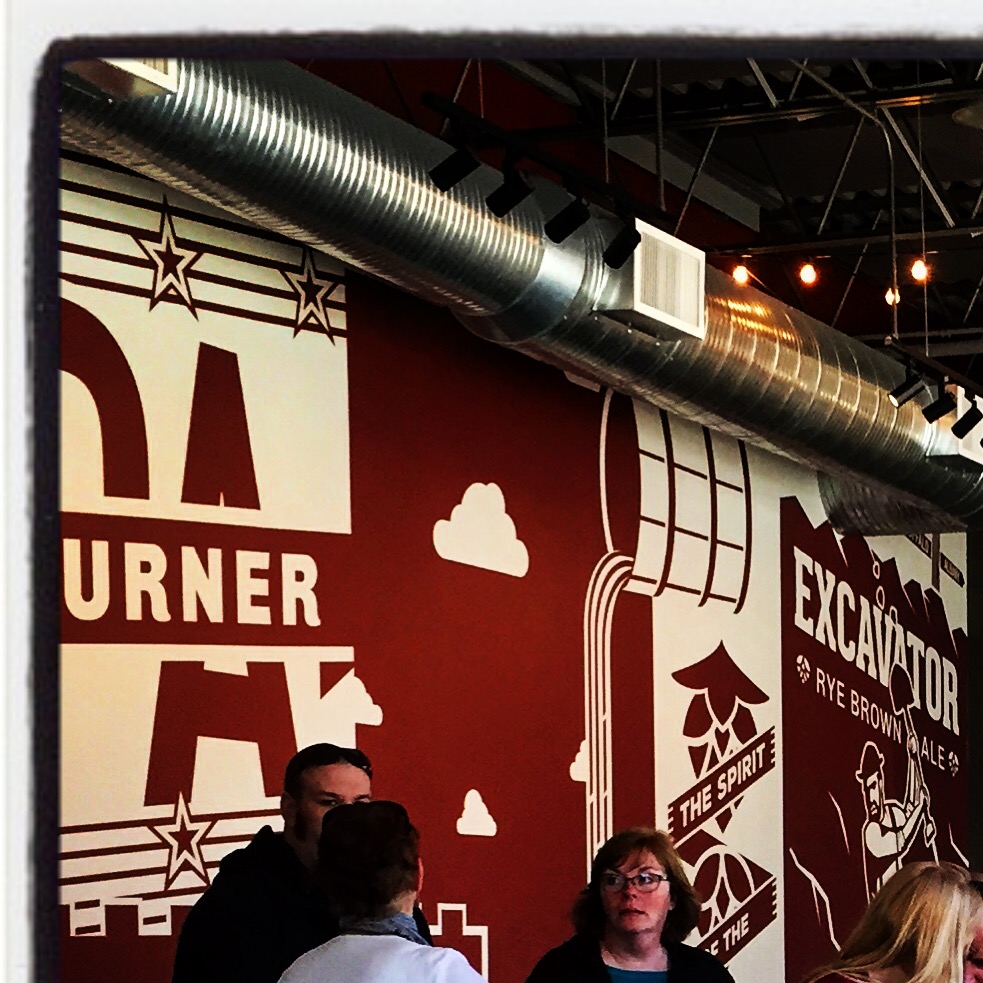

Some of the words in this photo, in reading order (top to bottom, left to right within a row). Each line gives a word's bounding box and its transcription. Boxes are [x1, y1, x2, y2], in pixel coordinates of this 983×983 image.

[61, 537, 322, 628] URNER
[793, 545, 960, 737] EXCAVATOR
[816, 667, 846, 709] RYE
[850, 688, 902, 745] BROWN
[921, 735, 946, 771] ALE
[679, 783, 712, 828] THE
[717, 742, 767, 802] SPIRIT
[722, 912, 750, 952] THE
